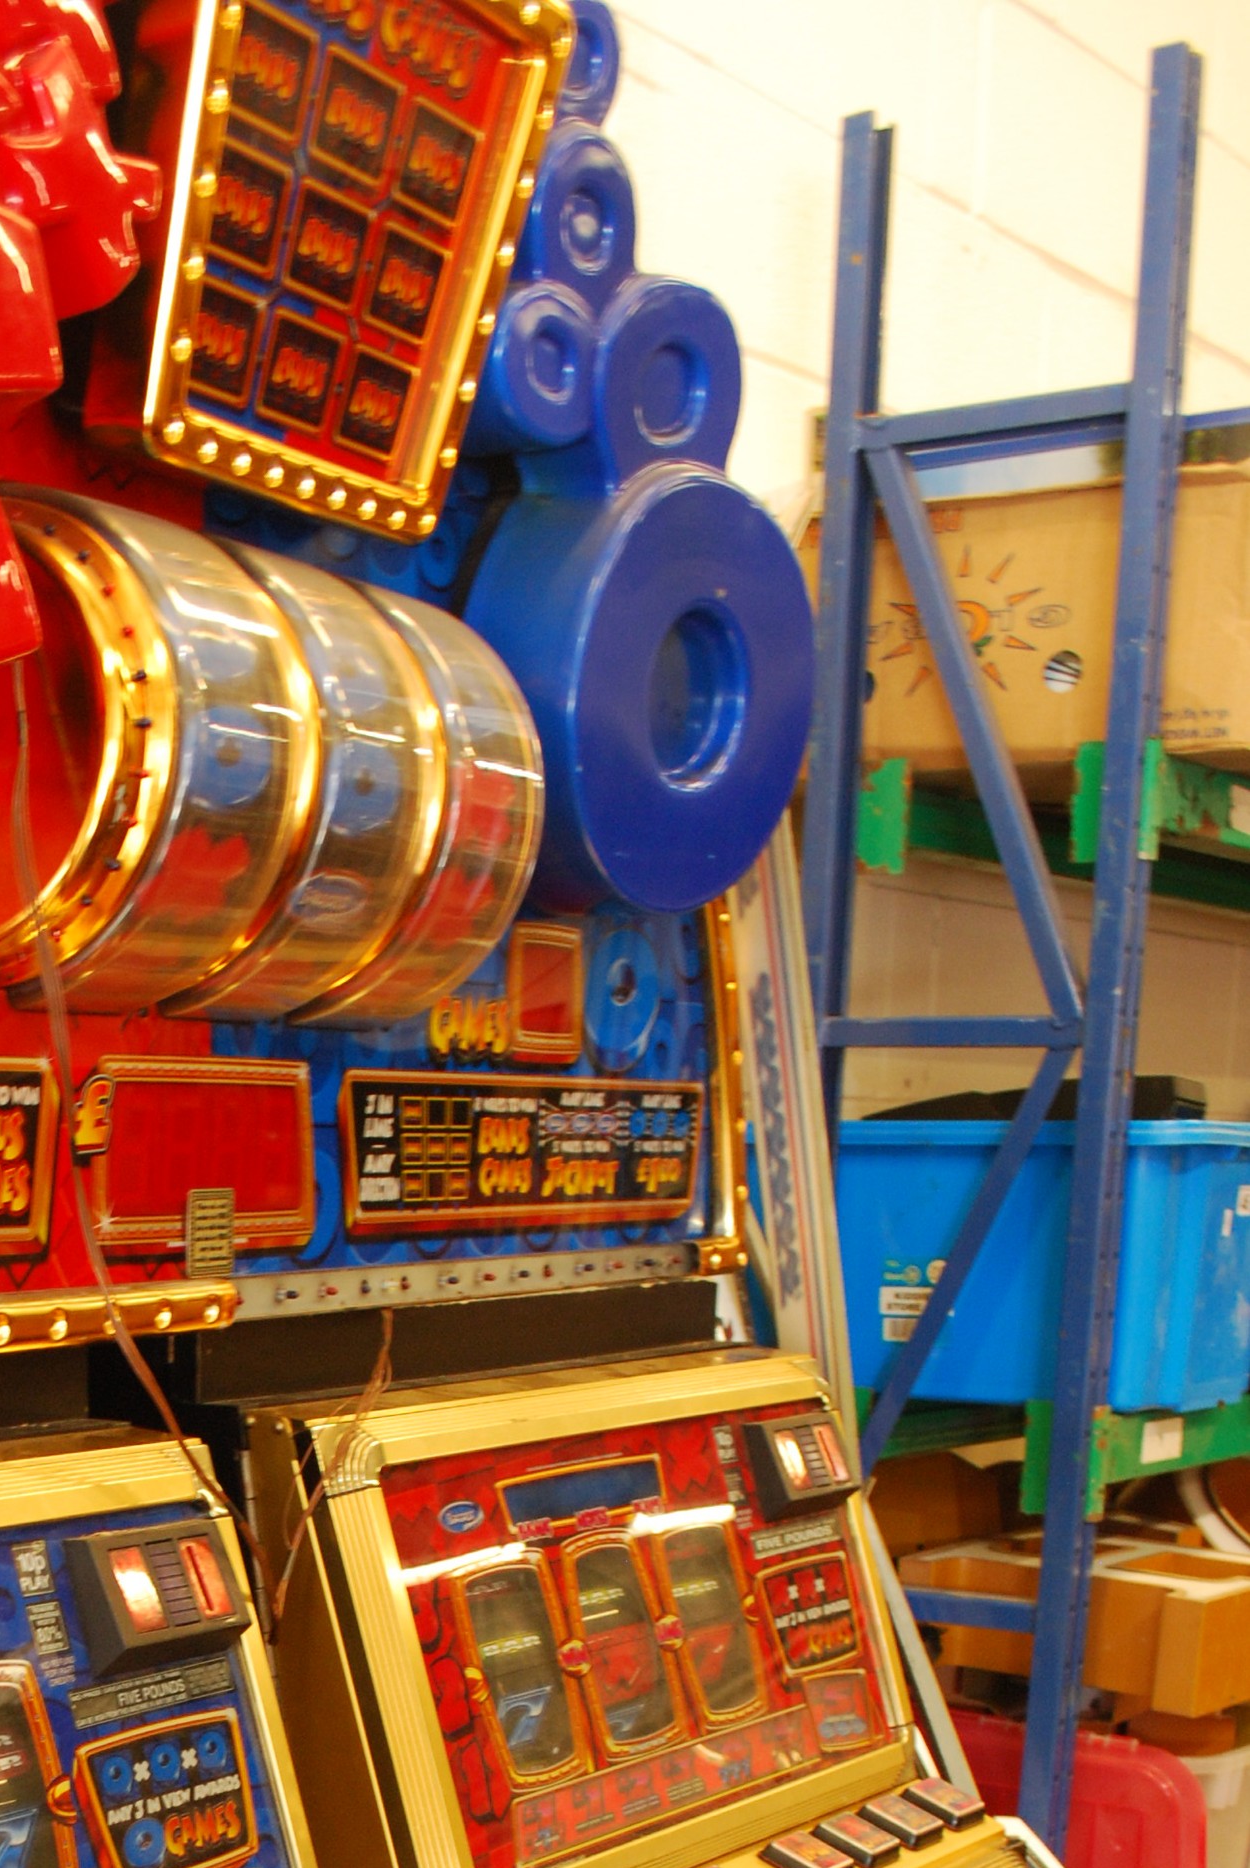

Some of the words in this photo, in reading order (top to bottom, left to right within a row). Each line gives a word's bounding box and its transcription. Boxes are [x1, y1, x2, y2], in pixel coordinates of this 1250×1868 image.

[75, 1079, 112, 1147] £
[117, 1690, 142, 1706] FIVE
[142, 1679, 186, 1700] POUNDS
[497, 1685, 553, 1748] 7
[107, 1804, 132, 1826] ANY
[131, 1799, 145, 1820] 3
[164, 1801, 241, 1857] GAMES
